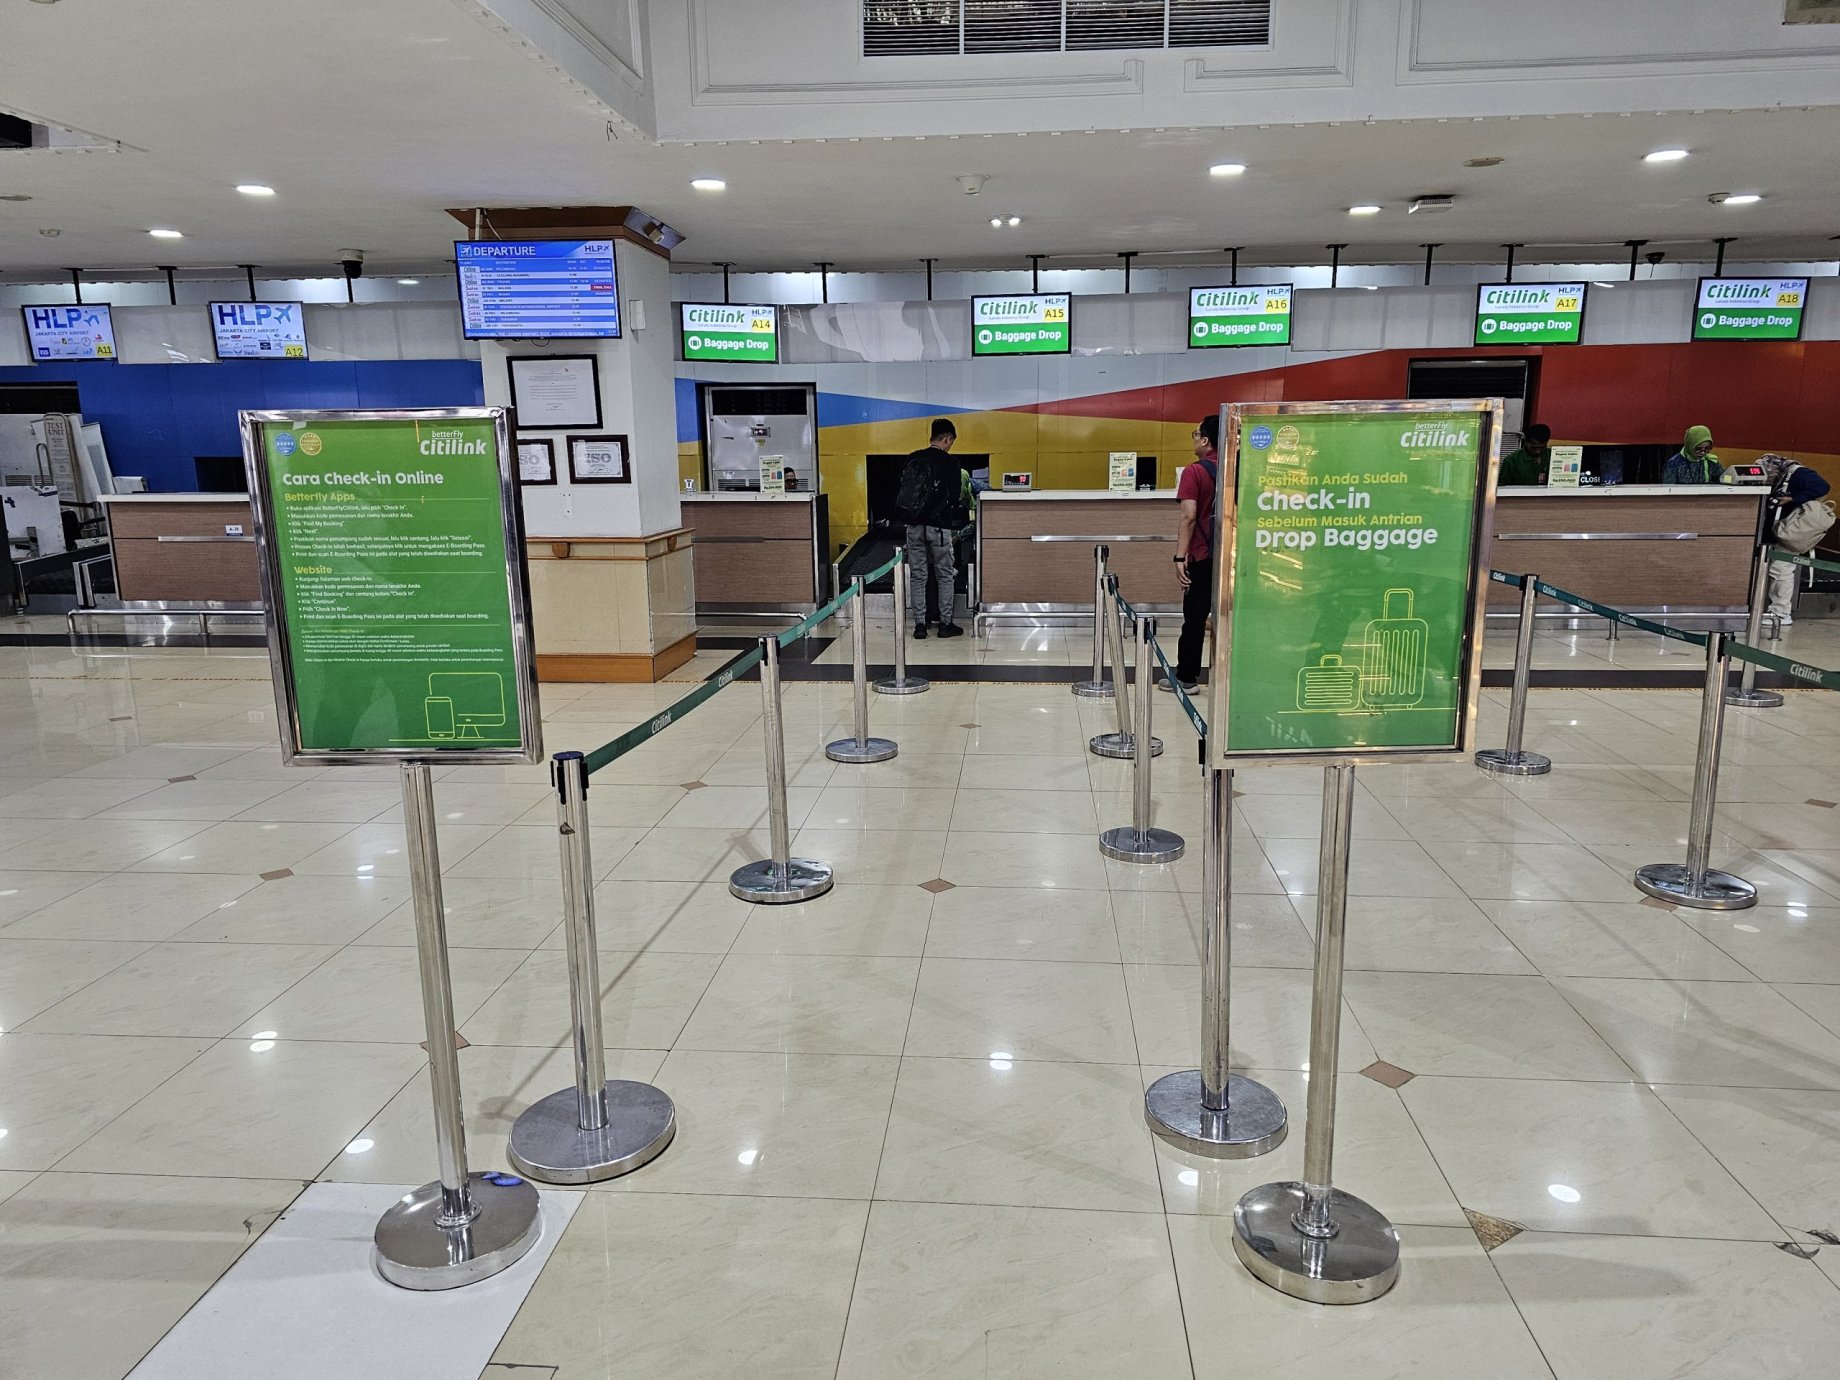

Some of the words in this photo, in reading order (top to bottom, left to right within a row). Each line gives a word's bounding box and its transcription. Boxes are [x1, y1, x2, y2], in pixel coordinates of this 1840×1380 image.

[474, 247, 536, 256] DEPARTURE
[1487, 290, 1550, 304] Citilink
[1707, 285, 1771, 298] Citilink
[1197, 291, 1259, 306] Citilink
[1266, 300, 1287, 309] A16
[1557, 299, 1577, 307] A17
[1778, 294, 1798, 303] A18
[981, 301, 1038, 315] Citilink
[1045, 309, 1064, 318] A15
[32, 309, 82, 328] HLP
[218, 305, 271, 325] HLP
[689, 309, 745, 323] Citilink
[1719, 316, 1764, 327] Baggage
[1767, 315, 1792, 327] Drop
[752, 320, 770, 328] A14
[1212, 324, 1256, 334] Baggage
[1259, 322, 1283, 333] Drop
[1500, 321, 1544, 332] Baggage
[1547, 320, 1572, 331] Drop
[995, 331, 1036, 342] Baggage
[1039, 330, 1061, 340] Drop
[97, 346, 112, 354] A11
[704, 338, 744, 350] Baggage
[747, 340, 768, 351] Drop
[286, 348, 304, 357] A12
[1415, 422, 1448, 431] betterFly
[432, 430, 463, 439] betterFly
[1400, 430, 1470, 448] Citilink
[420, 439, 487, 456] Citilink
[283, 472, 320, 486] Cara
[324, 471, 391, 485] Check-in
[395, 470, 444, 484] Online
[1258, 474, 1318, 486] Pastikan
[1323, 472, 1359, 485] Anda
[1363, 472, 1408, 484] Sudah
[285, 493, 327, 502] Betterfly
[330, 493, 355, 502] Apps
[1257, 486, 1370, 511] Check-in
[1257, 516, 1317, 528] Sebelum
[1321, 515, 1365, 526] Masuk
[1370, 513, 1422, 525] Antrian
[1256, 529, 1316, 550] Drop
[1324, 527, 1438, 550] Baggage
[294, 565, 332, 574] Website
[718, 670, 734, 688] Citilink
[1790, 663, 1823, 683] Citilink
[651, 711, 672, 735] Citilink
